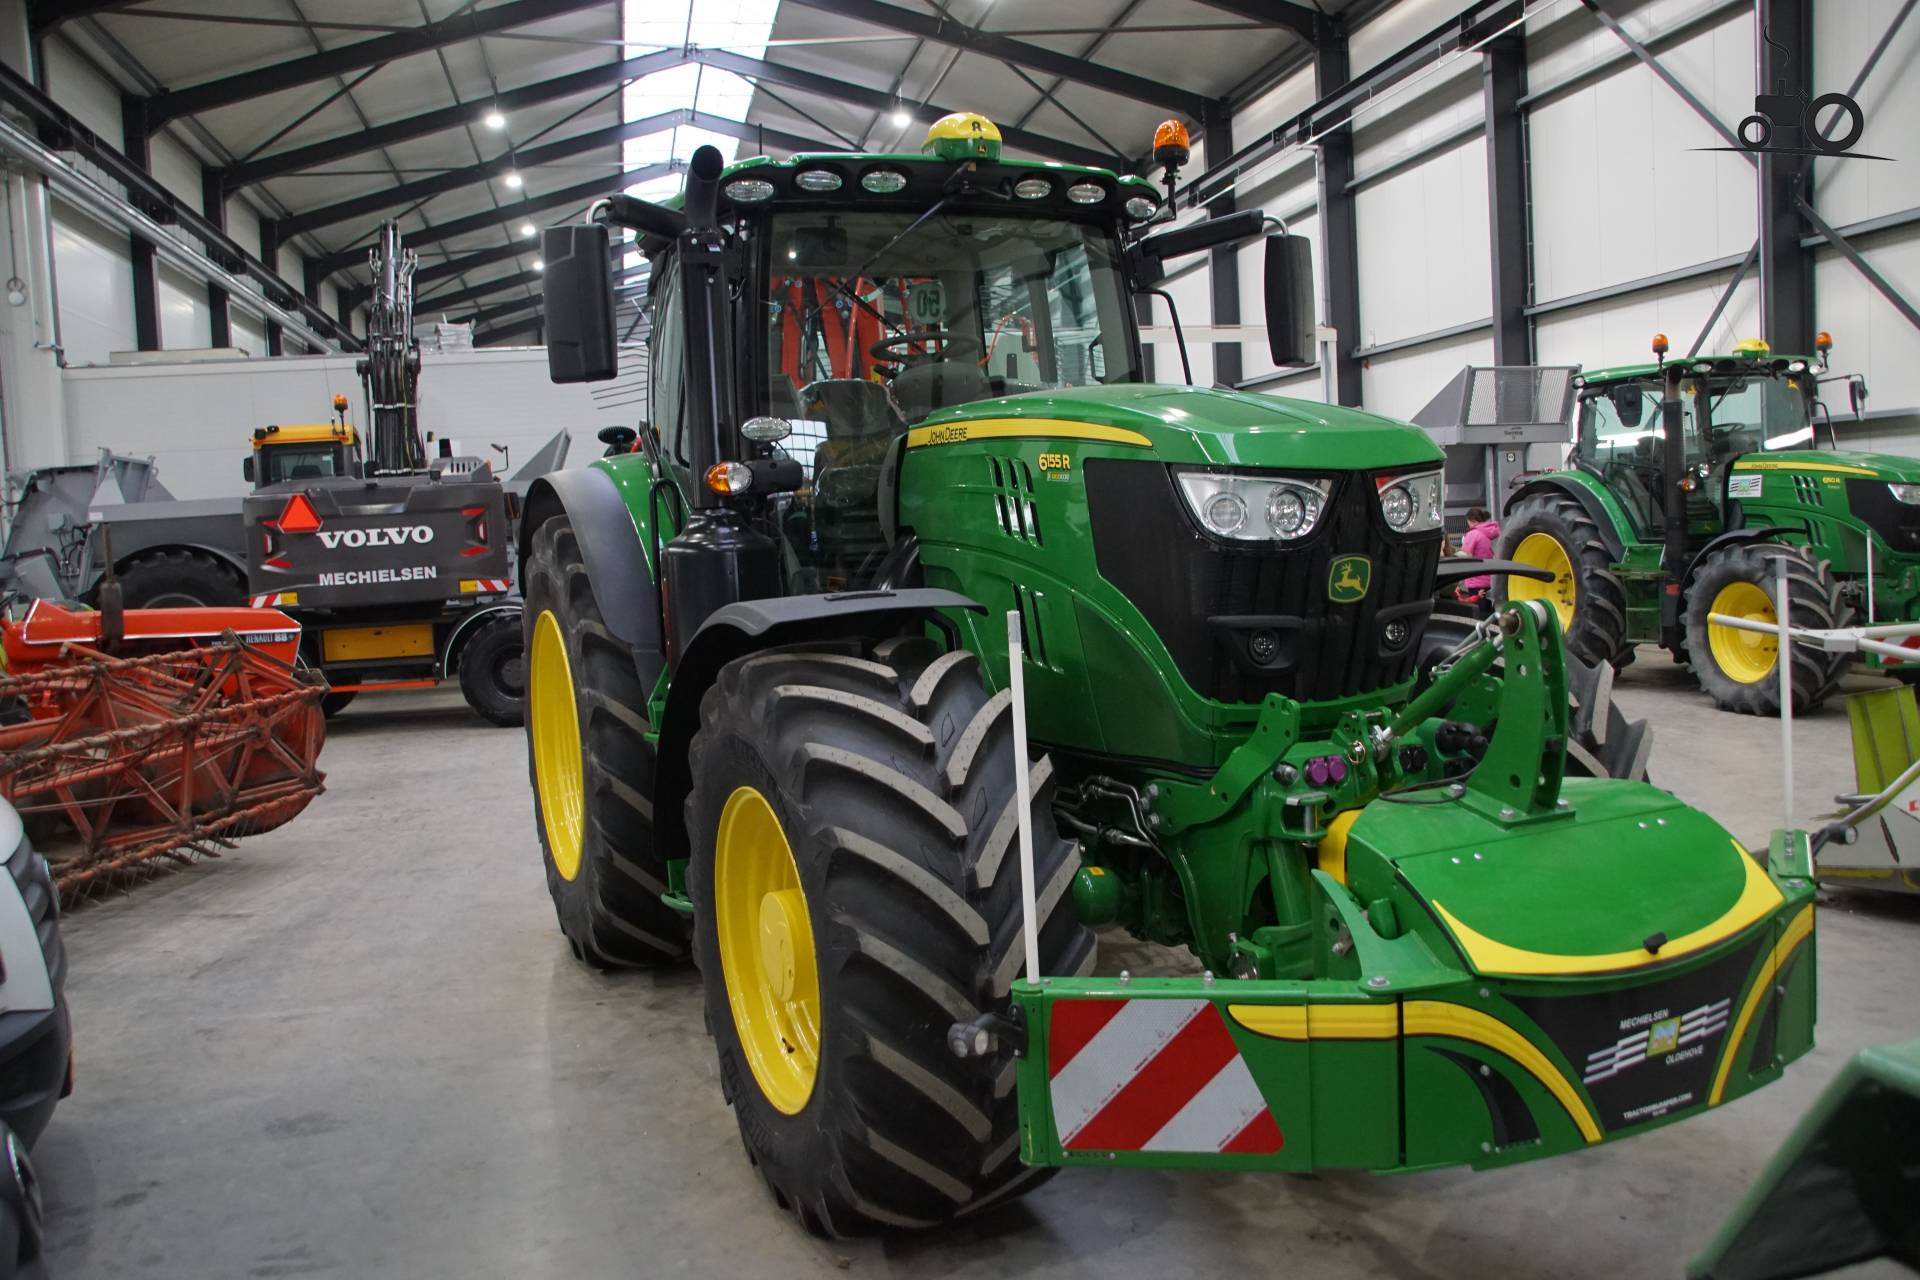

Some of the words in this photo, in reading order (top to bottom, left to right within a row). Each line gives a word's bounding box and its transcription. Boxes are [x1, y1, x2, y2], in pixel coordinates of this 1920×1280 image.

[945, 427, 967, 441] DEERE
[1039, 454, 1061, 470] 6155
[1063, 455, 1070, 469] R
[316, 525, 434, 549] VOLVO
[319, 566, 437, 586] MECHIELSEN
[246, 632, 273, 644] RENAULT
[1619, 1009, 1669, 1029] MECHIELSEN
[1666, 1045, 1702, 1065] OLDEHOVE
